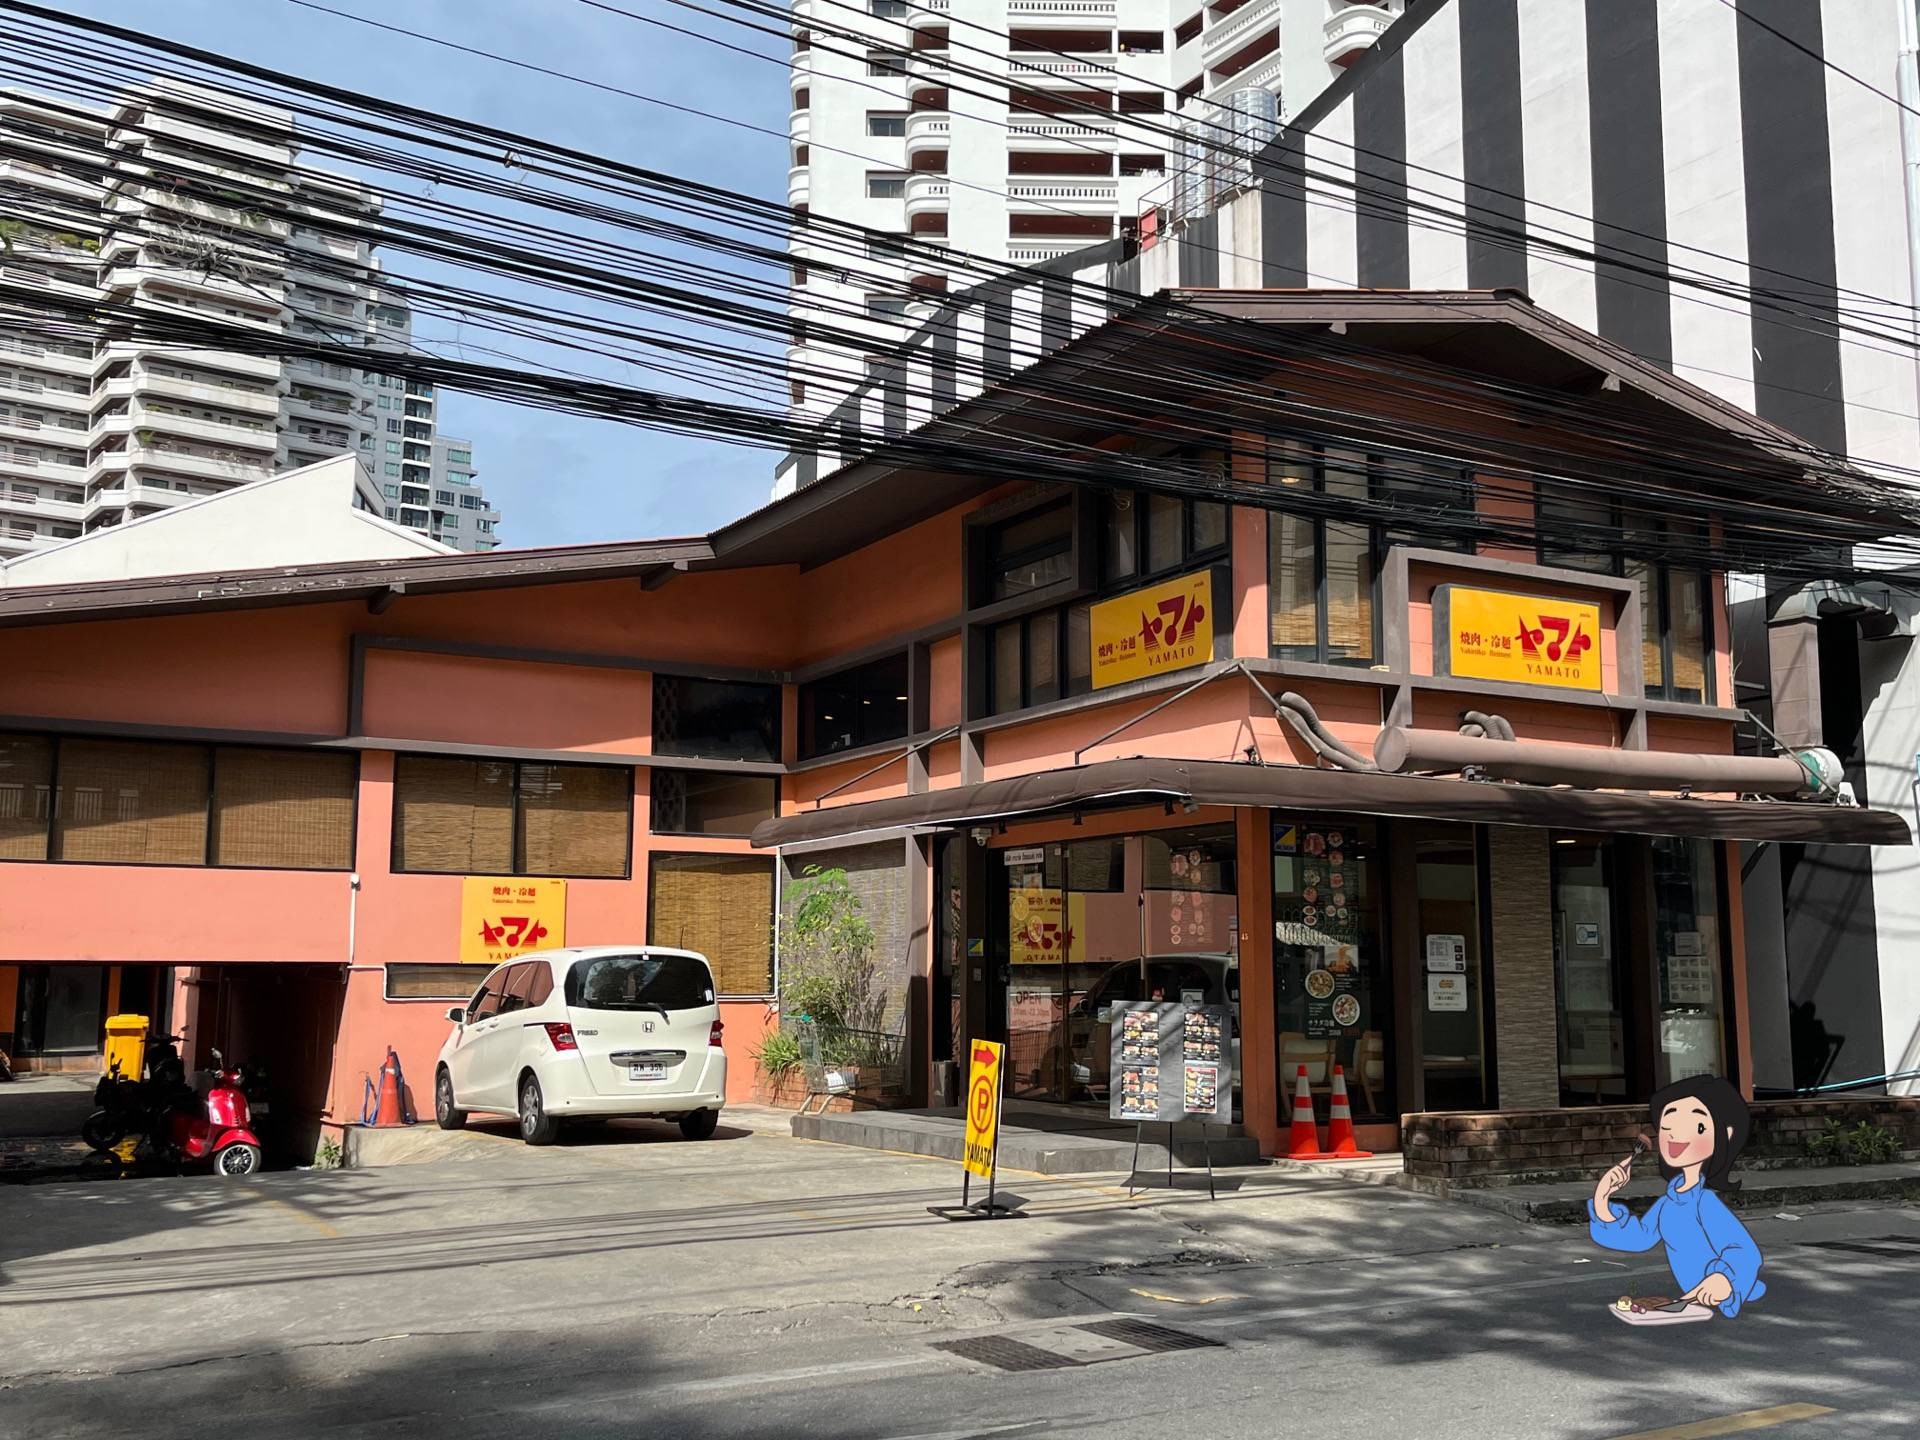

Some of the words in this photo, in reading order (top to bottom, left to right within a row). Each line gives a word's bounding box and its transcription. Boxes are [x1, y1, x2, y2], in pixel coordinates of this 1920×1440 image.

[1148, 645, 1194, 666] YAMATO
[1526, 663, 1580, 679] YAMATO
[1016, 991, 1042, 1005] OPEN
[977, 1087, 989, 1121] P
[966, 1142, 991, 1168] YAMATO
